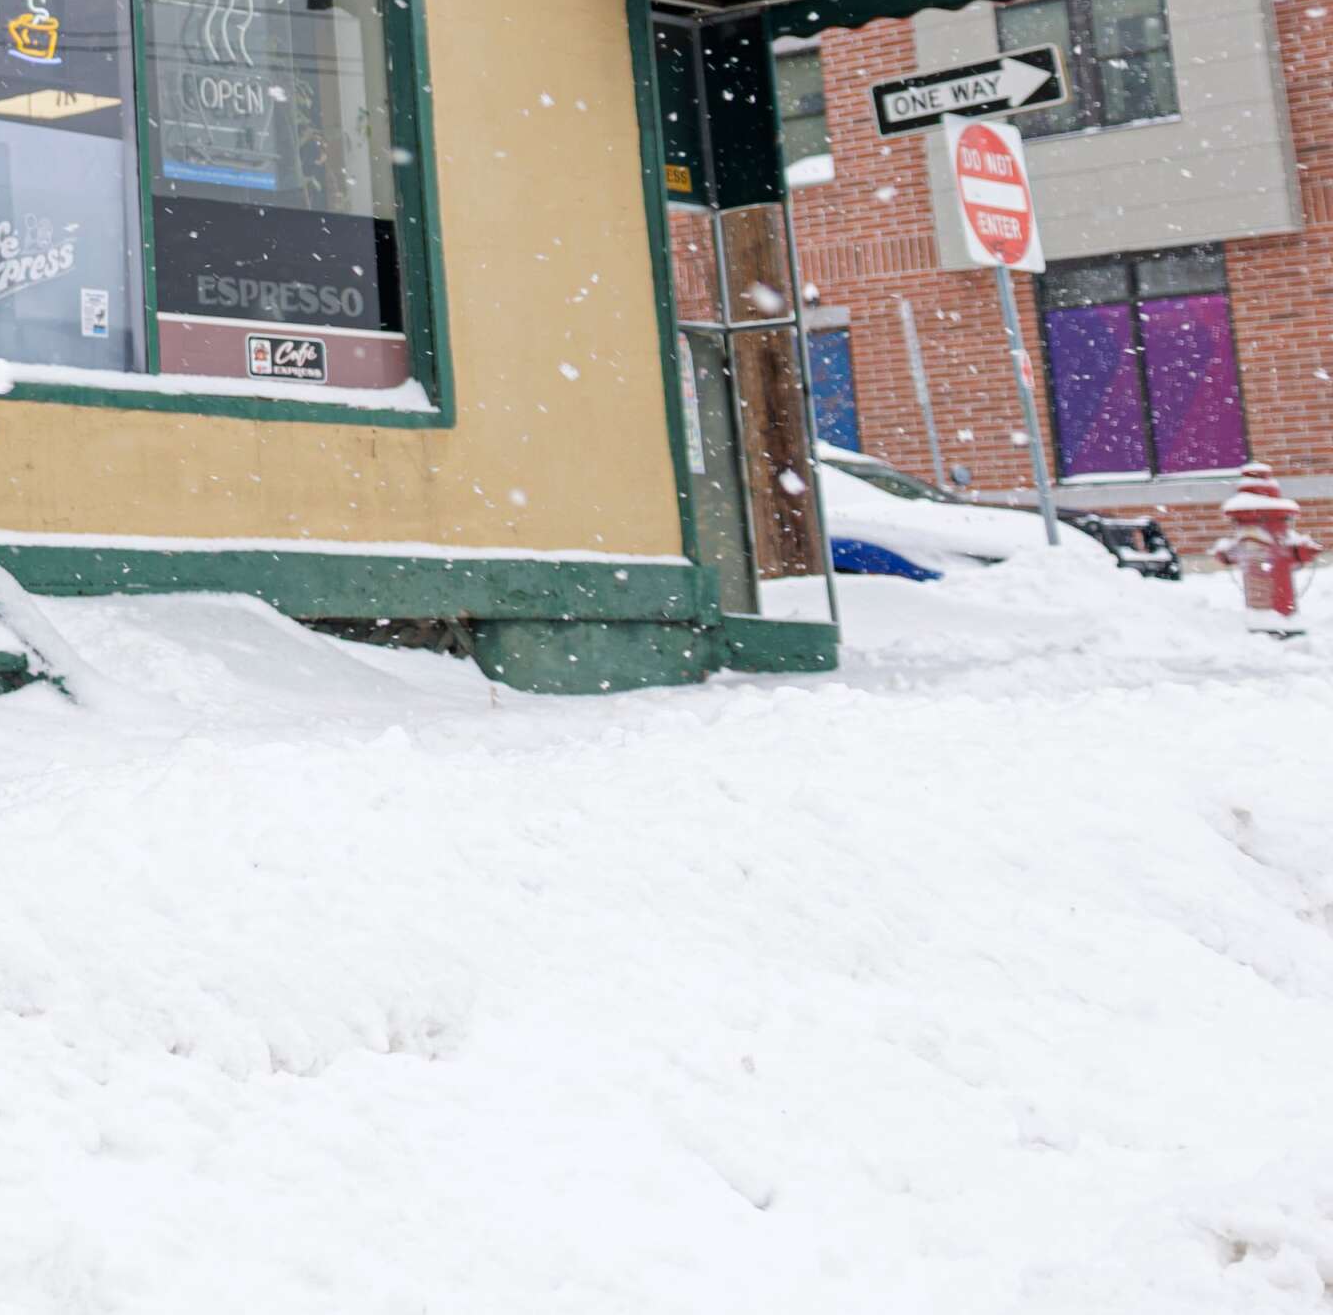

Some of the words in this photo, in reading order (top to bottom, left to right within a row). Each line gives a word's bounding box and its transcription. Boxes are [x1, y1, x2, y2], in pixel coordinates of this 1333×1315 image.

[200, 76, 264, 115] OPEN
[894, 89, 945, 115] ONE
[951, 75, 1002, 102] WAY
[960, 146, 982, 171] DO
[986, 152, 1015, 177] NOT
[976, 211, 1023, 240] ENTER
[197, 275, 364, 317] ESPRESSO
